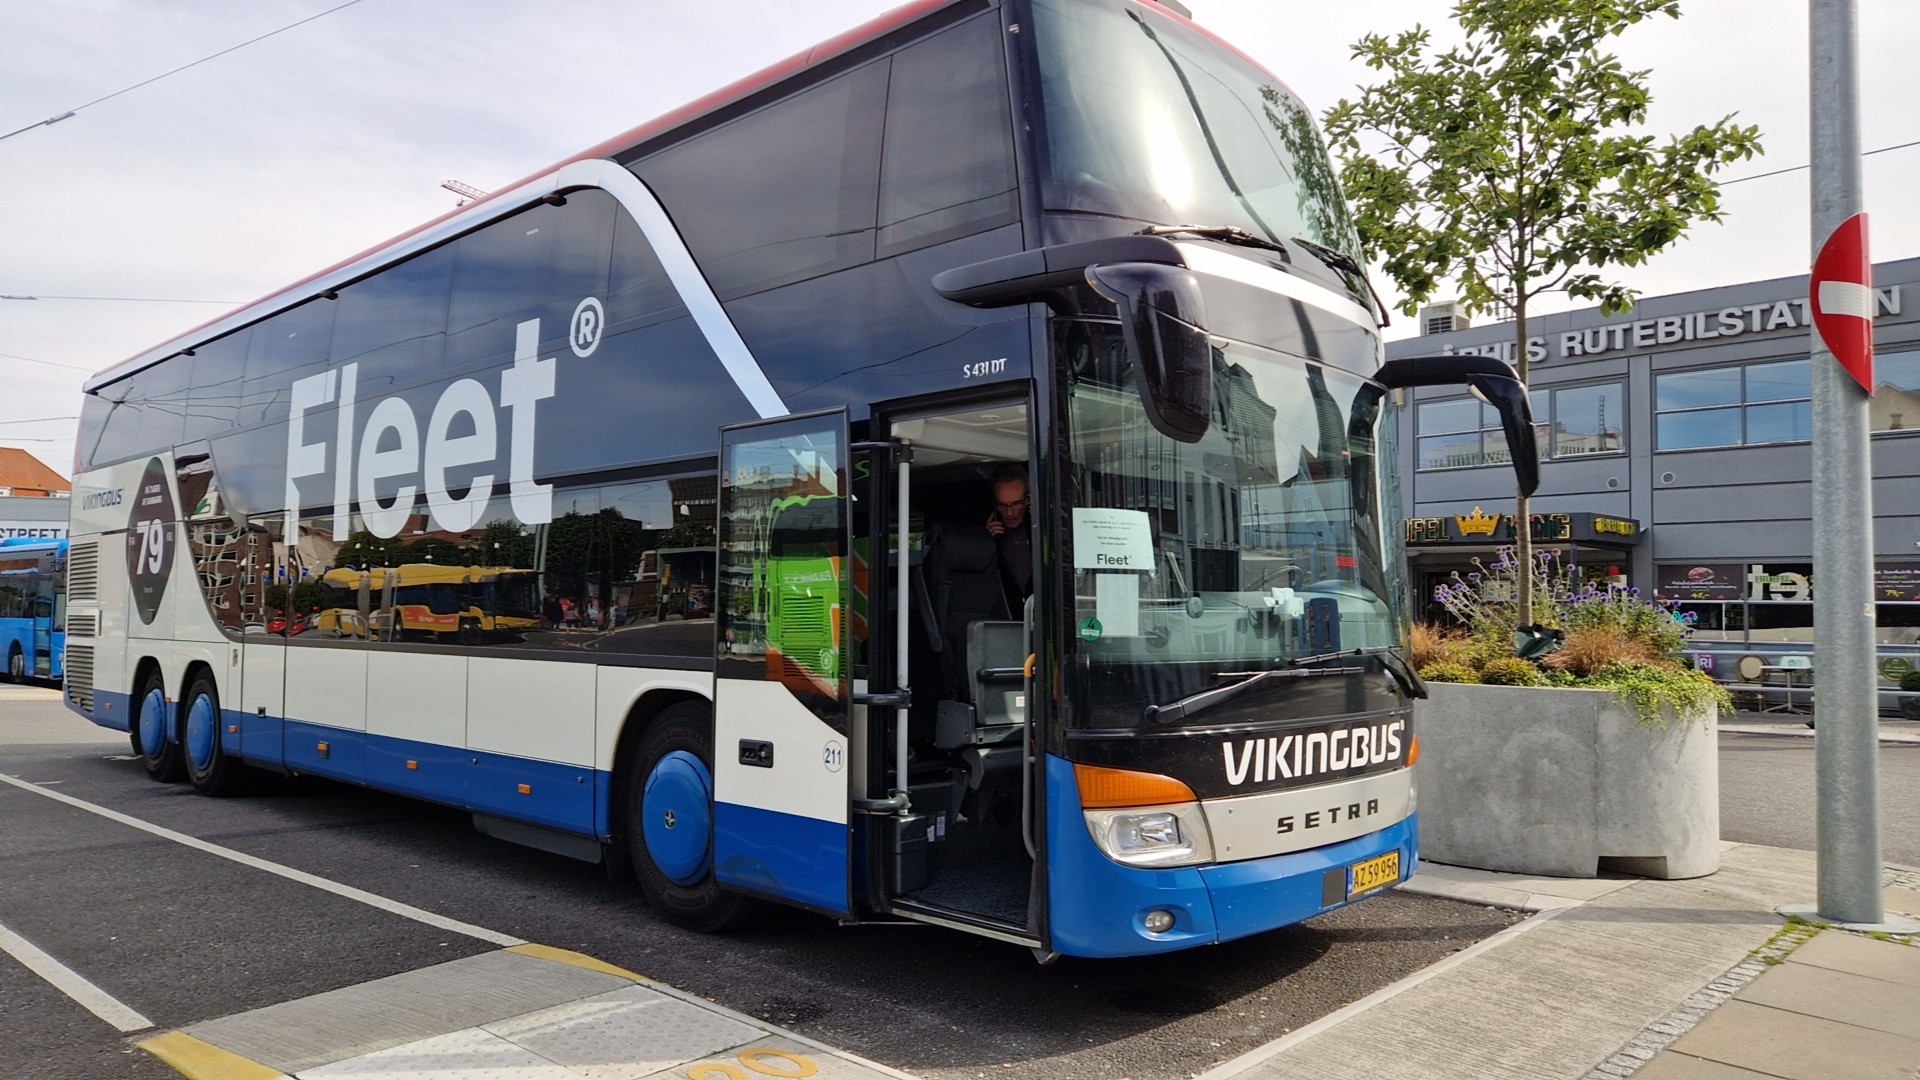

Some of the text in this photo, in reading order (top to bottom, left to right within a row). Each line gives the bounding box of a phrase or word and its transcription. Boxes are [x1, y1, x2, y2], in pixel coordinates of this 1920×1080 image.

[1561, 285, 1900, 358] RUTEBILSTATN
[963, 358, 1007, 378] S 431 DT
[1504, 513, 1570, 540] KNG
[136, 518, 164, 575] 79
[824, 747, 841, 765] 211
[1223, 720, 1405, 786] VIKINGBUS
[1277, 798, 1379, 834] SETRA
[1354, 867, 1366, 889] AZ
[1368, 863, 1379, 884] 59
[1381, 856, 1397, 879] 956
